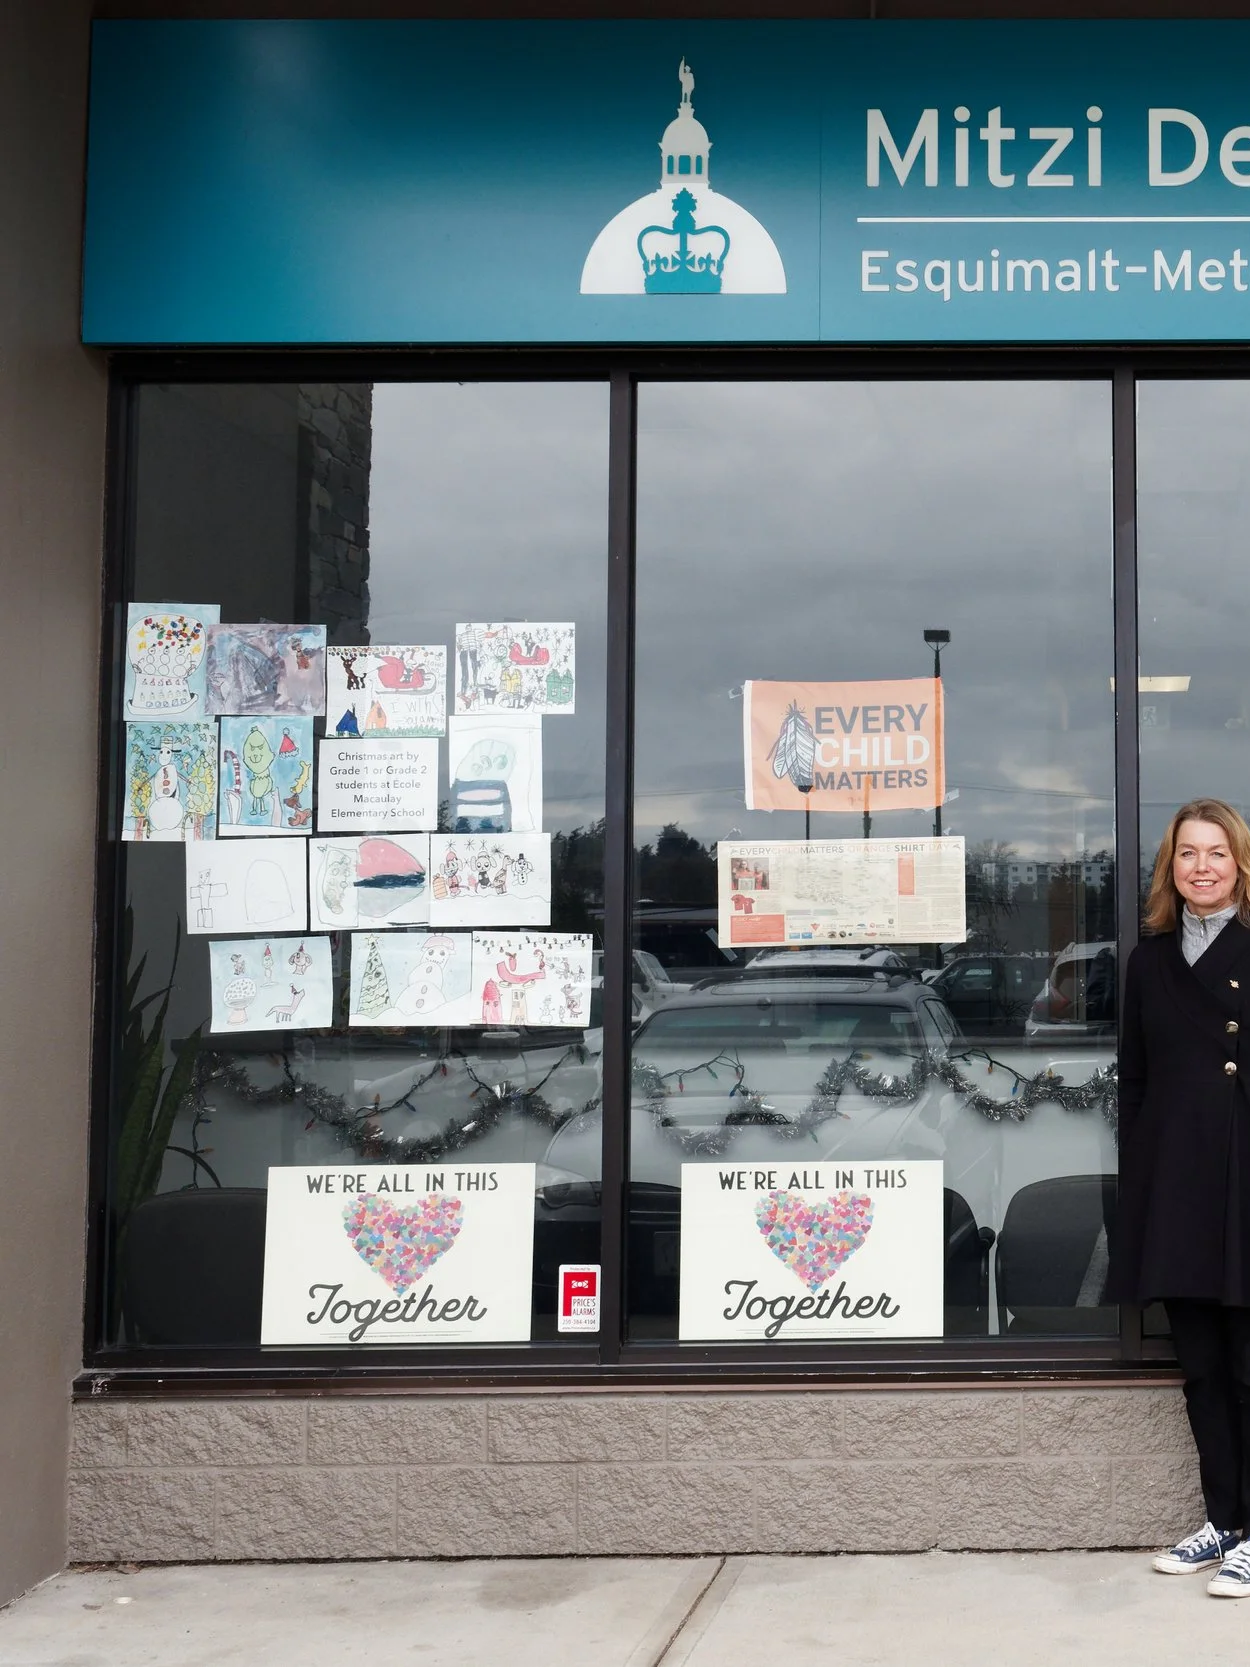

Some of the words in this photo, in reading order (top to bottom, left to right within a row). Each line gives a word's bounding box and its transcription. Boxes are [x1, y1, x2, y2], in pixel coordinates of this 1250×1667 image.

[866, 105, 1104, 188] Mitzi
[815, 703, 928, 735] EVERY
[338, 752, 387, 761] Christmas
[389, 752, 404, 761] art
[406, 751, 419, 762] by
[815, 735, 930, 768] CHILD
[329, 766, 361, 775] Grade
[363, 766, 369, 775] 1
[386, 765, 418, 775] Grade
[420, 765, 428, 774] 2
[335, 780, 378, 790] students
[380, 781, 391, 789] at
[815, 768, 928, 791] MATTERS
[353, 794, 402, 805] Macaulay
[331, 809, 388, 819] Elementary
[390, 807, 425, 817] School
[739, 847, 771, 856] EVERY
[800, 846, 845, 855] MATTERS
[893, 844, 926, 852] SHIRT
[306, 1173, 367, 1194] WE'RE
[377, 1173, 415, 1193] ALL
[426, 1172, 445, 1192] IN
[454, 1171, 499, 1191] THIS
[718, 1170, 778, 1190] WE'RE
[787, 1170, 825, 1190] ALL
[835, 1170, 854, 1189] IN
[863, 1168, 908, 1189] THIS
[572, 1298, 596, 1307] PRICE'S
[723, 1279, 901, 1338] Together
[306, 1283, 488, 1342] Together
[572, 1307, 596, 1316] ALARMS
